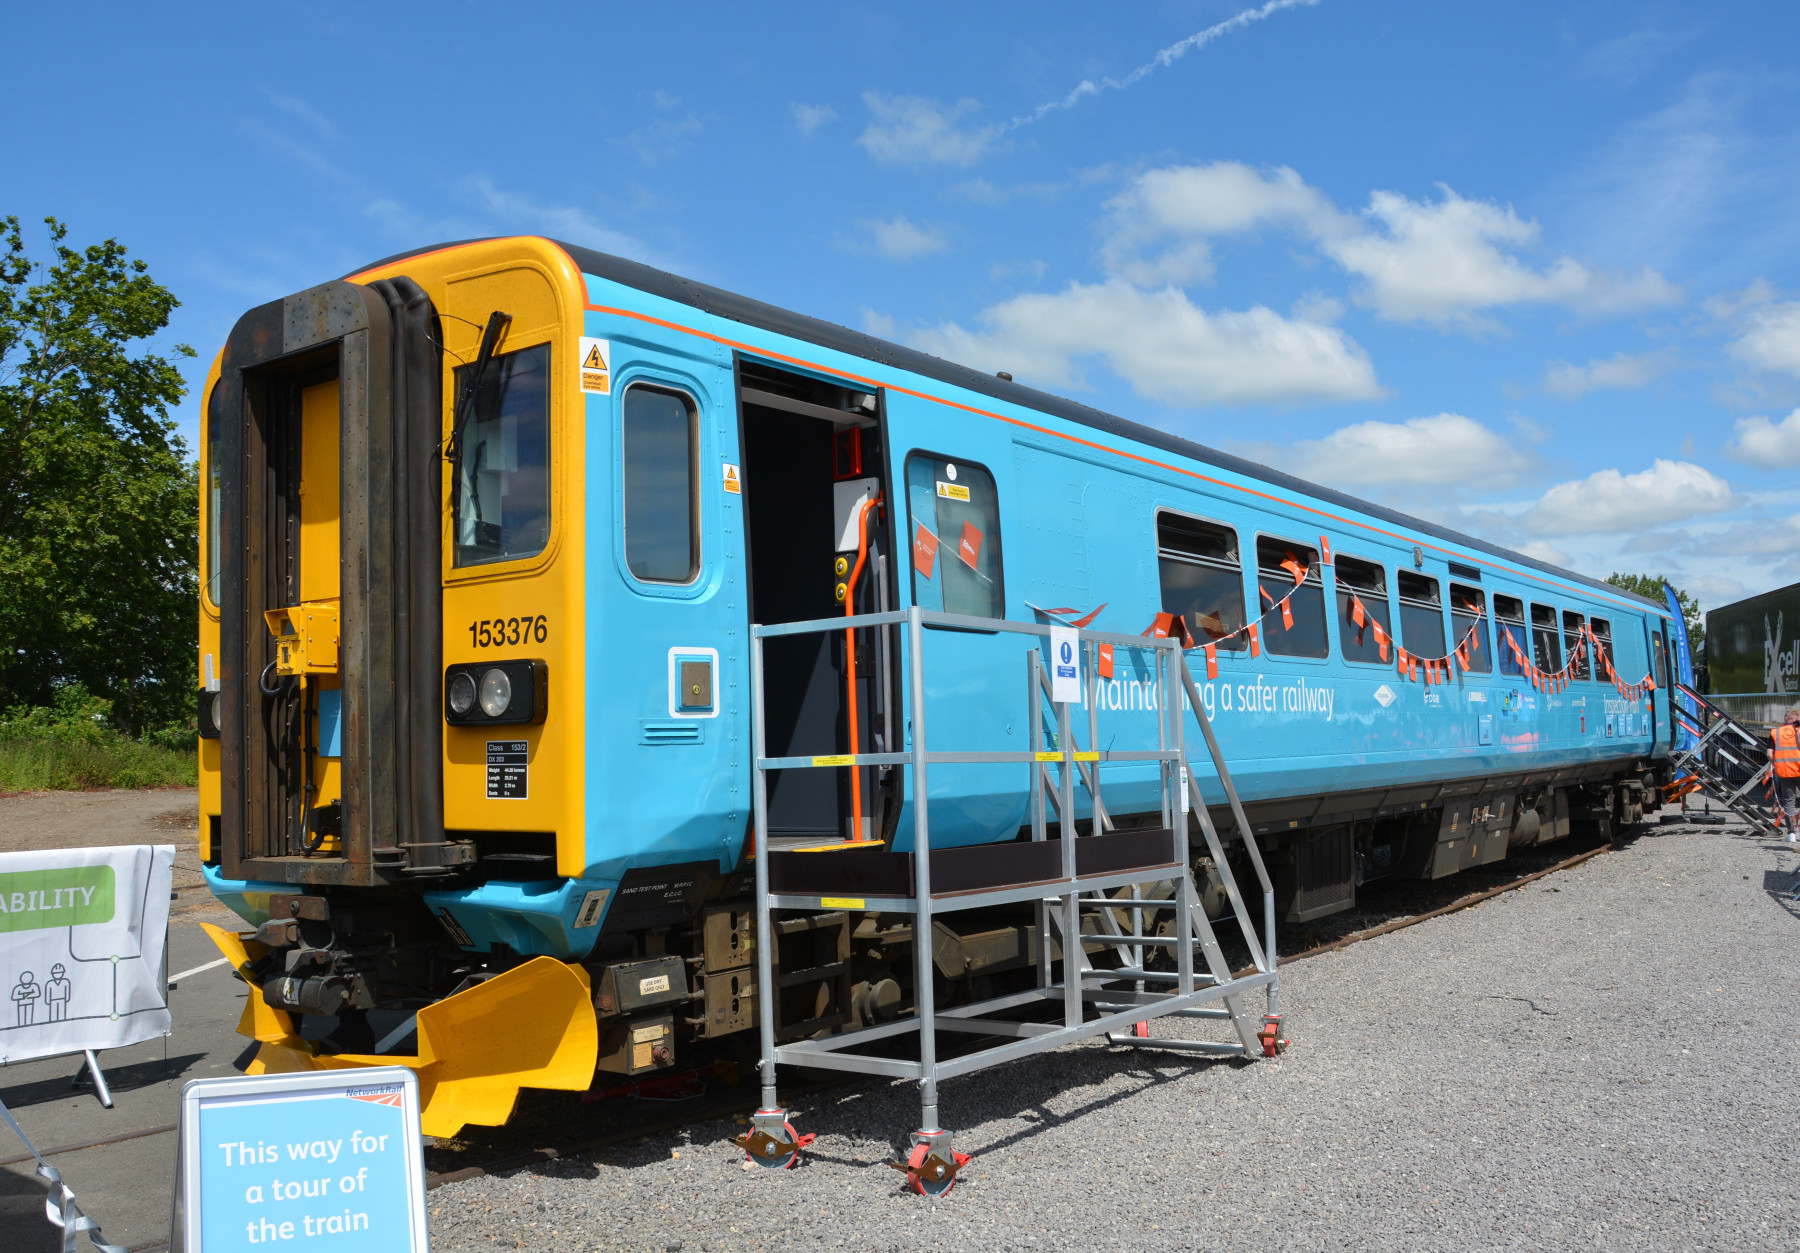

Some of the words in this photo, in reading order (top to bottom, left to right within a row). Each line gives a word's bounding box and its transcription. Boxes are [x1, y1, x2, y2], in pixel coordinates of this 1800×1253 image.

[469, 614, 548, 648] 153376
[1221, 683, 1233, 711] a
[1237, 674, 1279, 712] safer
[1283, 677, 1334, 722] railway
[488, 744, 504, 752] Class
[638, 885, 653, 893] TEST
[650, 883, 669, 891] POINT
[218, 1140, 279, 1167] This
[286, 1139, 343, 1164] way
[350, 1129, 389, 1154] for
[245, 1184, 264, 1204] a
[271, 1177, 331, 1201] tour
[339, 1166, 369, 1193] of
[246, 1217, 295, 1244] the
[302, 1208, 369, 1237] train
